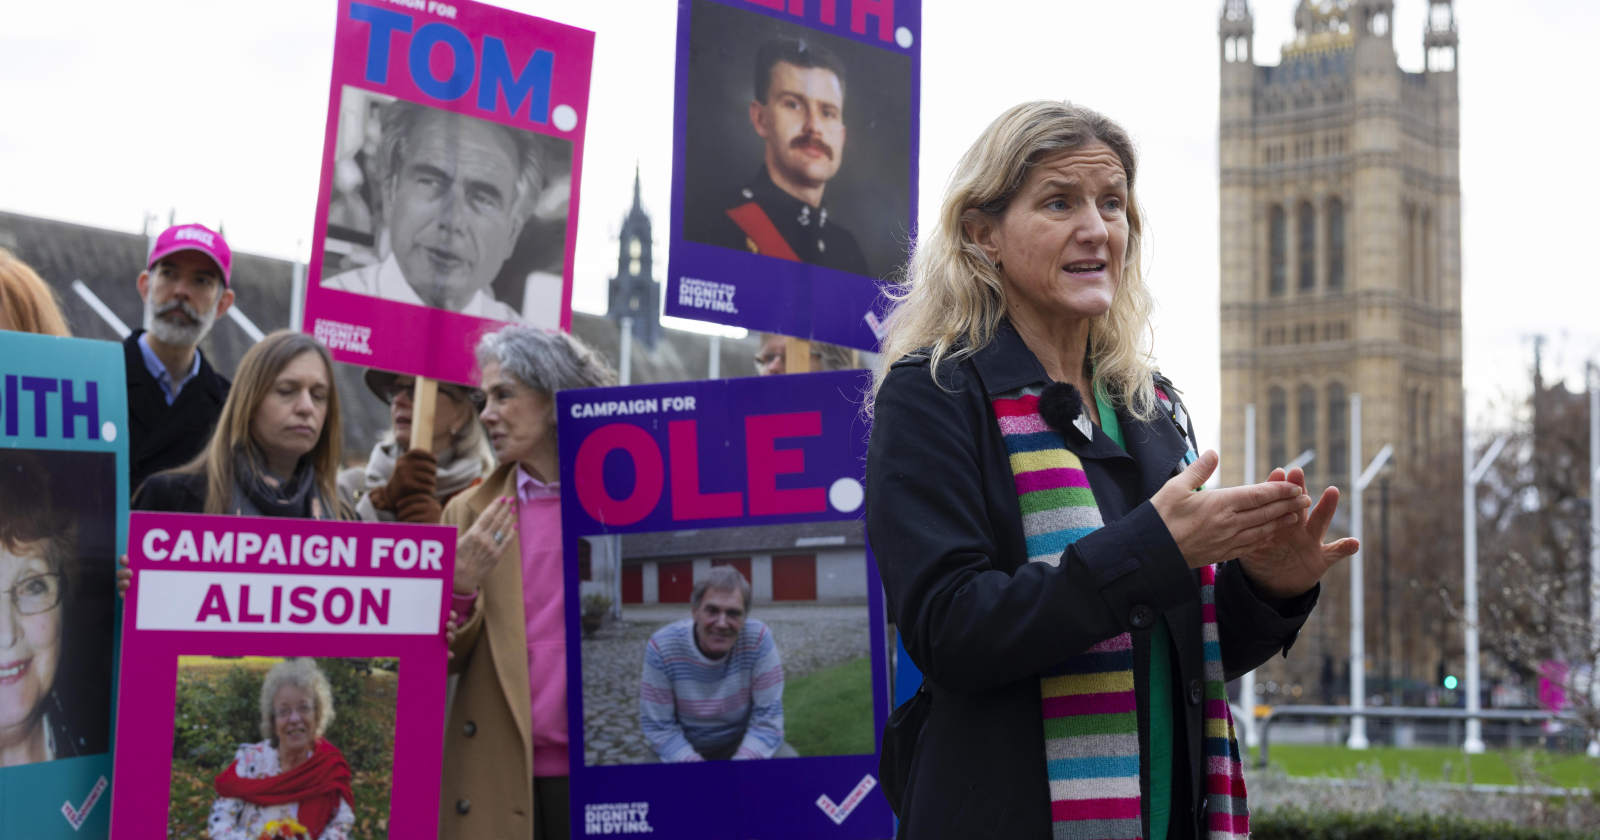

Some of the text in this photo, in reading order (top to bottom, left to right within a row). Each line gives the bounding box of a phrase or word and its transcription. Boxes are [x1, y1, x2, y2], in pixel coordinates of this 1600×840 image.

[428, 1, 457, 19] FOR
[349, 2, 578, 132] TOM.
[679, 283, 735, 302] DIGNITY
[679, 295, 739, 314] IN DYING.
[314, 324, 371, 343] DIGNITY
[0, 374, 117, 442] ITH.
[571, 396, 696, 419] CAMPAIGN FOR
[574, 411, 865, 526] OLE.
[142, 528, 444, 571] CAMPAIGN FOR
[195, 584, 391, 626] ALISON
[585, 809, 648, 823] DIGNITY
[585, 820, 654, 835] IN DYING.
